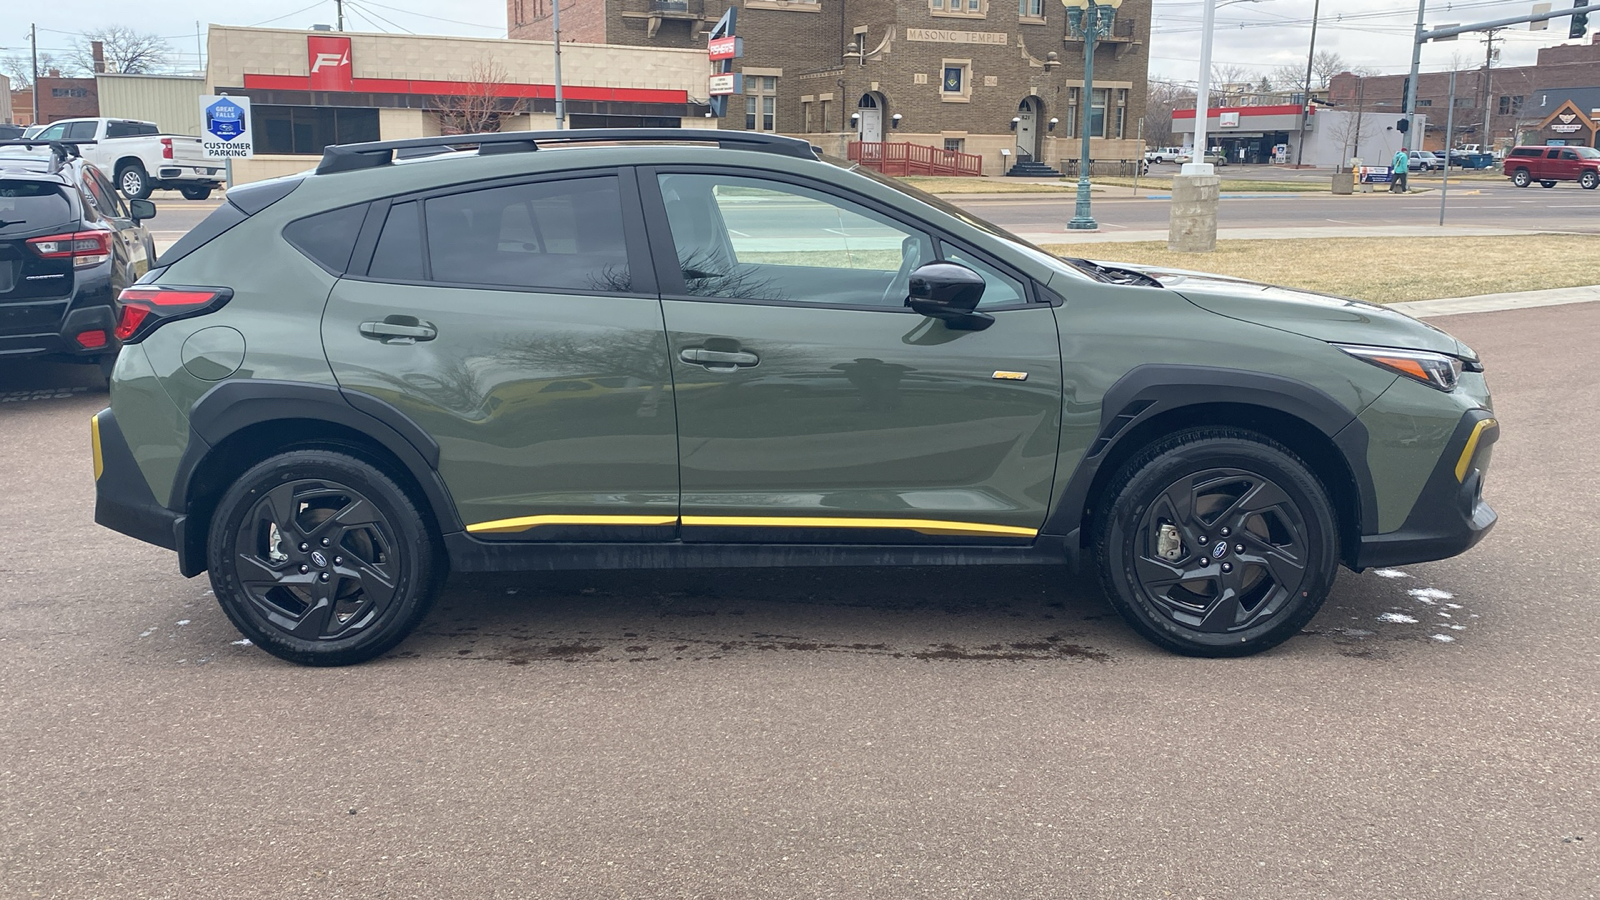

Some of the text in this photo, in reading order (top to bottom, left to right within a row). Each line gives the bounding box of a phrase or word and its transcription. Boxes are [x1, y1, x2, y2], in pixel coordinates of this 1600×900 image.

[909, 30, 1006, 43] MASONIC TEMPLE
[204, 142, 251, 150] CUSTOMER
